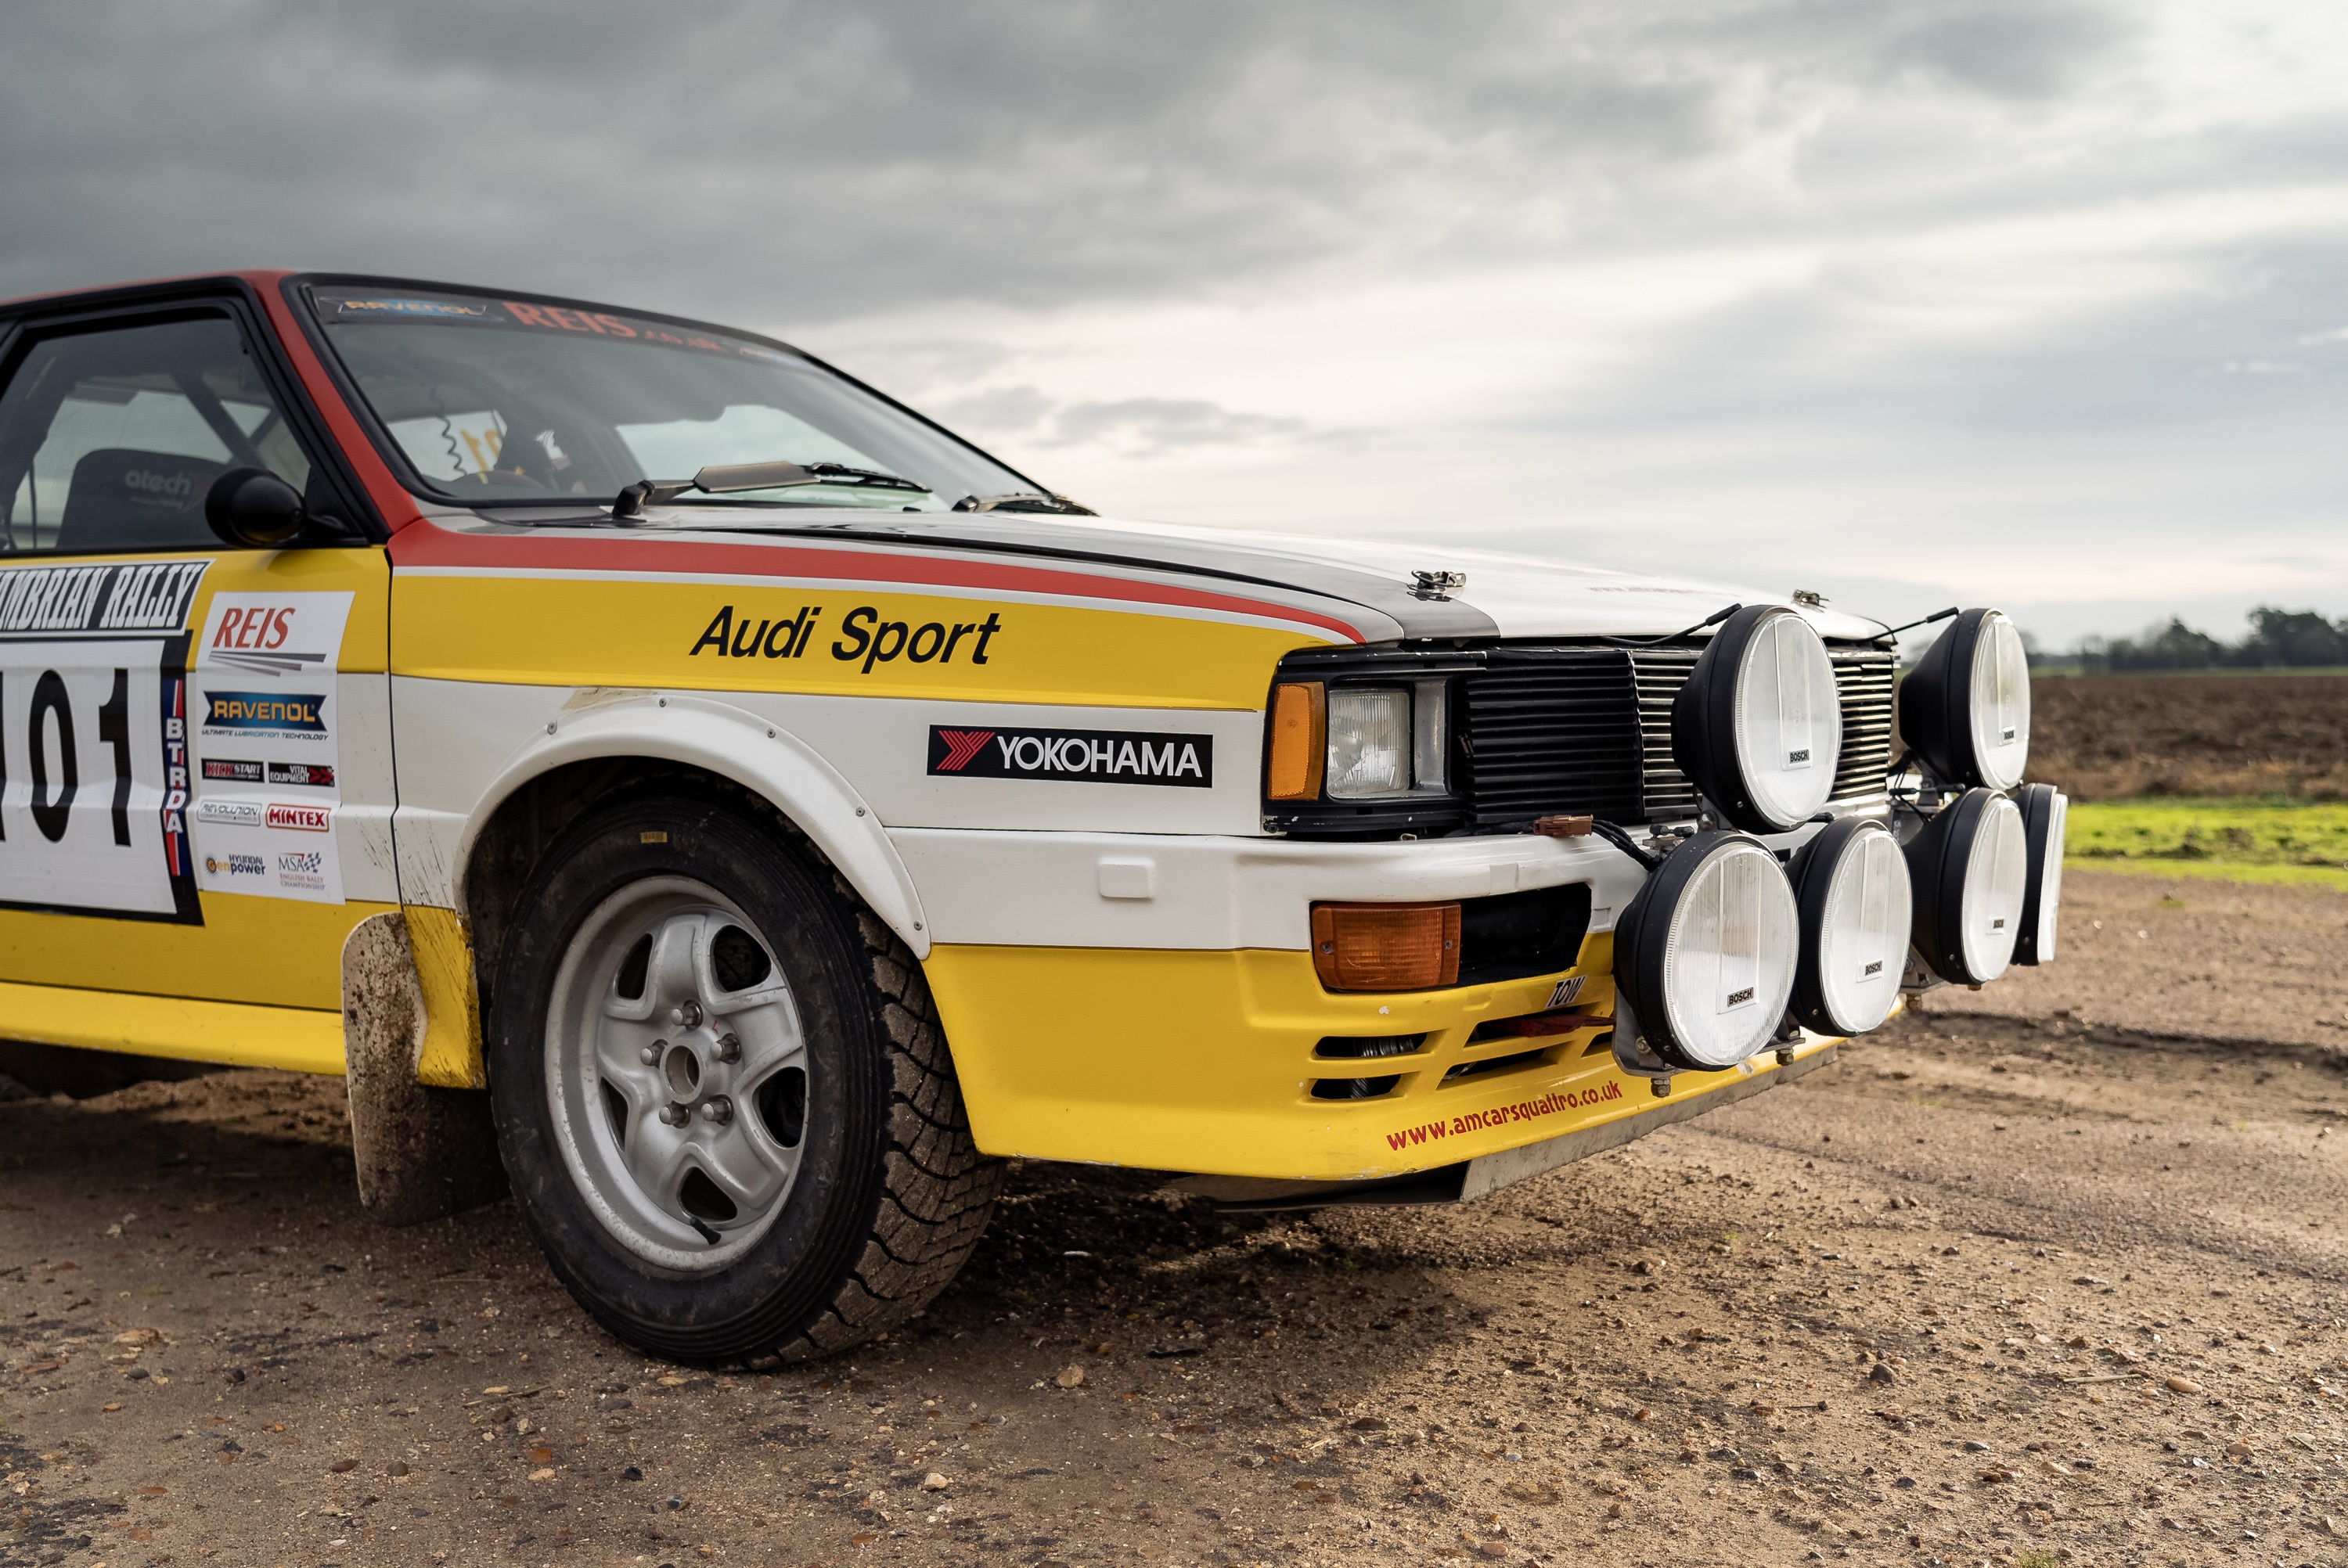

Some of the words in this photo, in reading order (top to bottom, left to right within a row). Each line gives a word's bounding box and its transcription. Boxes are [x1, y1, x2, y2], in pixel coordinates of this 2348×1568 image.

[502, 301, 638, 338] REIS
[99, 563, 205, 628] RALLY
[212, 607, 297, 649] REIS
[688, 605, 823, 659] Audi
[831, 606, 1002, 674] Sport
[214, 700, 315, 722] RAVENOL
[201, 728, 232, 737] ULTIMATE
[235, 730, 279, 739] LUBRICATION
[282, 732, 329, 741] TECHNOLOGY
[996, 735, 1203, 778] YOKOHAMA
[1789, 750, 1809, 763] BOSCH
[166, 718, 186, 833] BTRDA
[269, 771, 310, 783] EQUIPMENT
[289, 765, 308, 774] VITAL
[203, 804, 258, 816] REVOLUTION
[268, 809, 325, 827] MINTEX
[229, 854, 263, 865] HYUNDAI
[279, 856, 305, 872] MSA
[1547, 976, 1586, 1008] TOW
[1728, 987, 1753, 1005] BOSCH
[1386, 1080, 1623, 1151] www.amcarsquattro.co.uk
